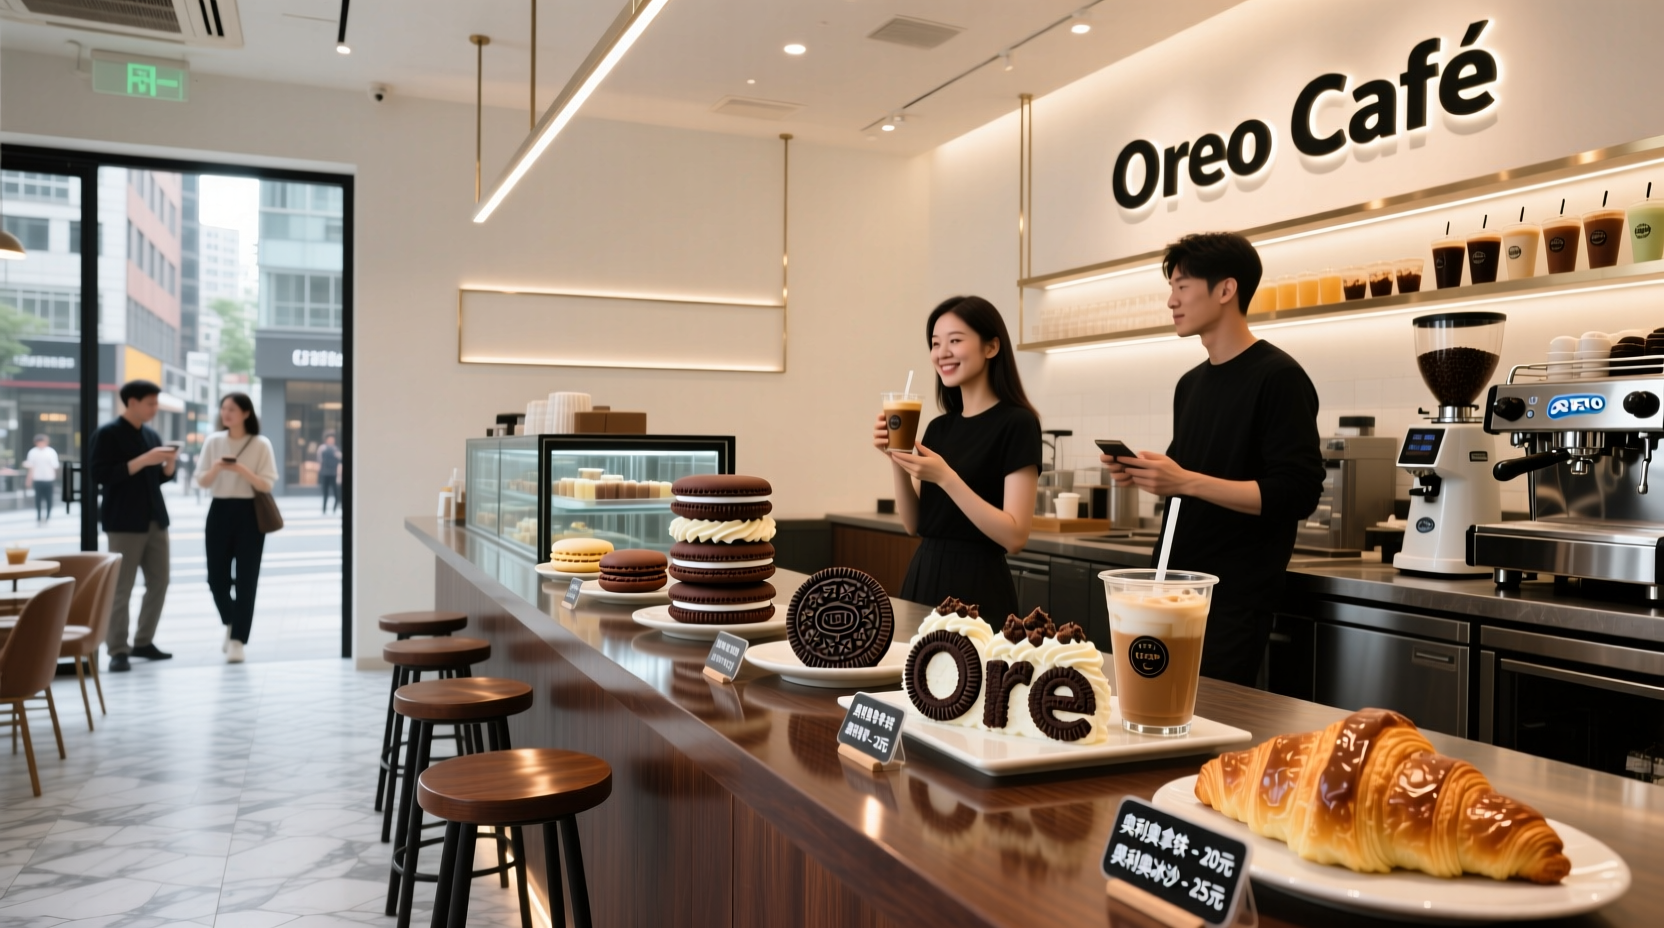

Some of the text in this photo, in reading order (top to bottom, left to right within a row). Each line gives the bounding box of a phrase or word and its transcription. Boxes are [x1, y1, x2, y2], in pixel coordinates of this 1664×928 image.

[1112, 20, 1497, 209] Oreo Café
[904, 629, 1097, 742] Ore
[1188, 877, 1226, 911] 25元
[1199, 846, 1235, 878] 20元
